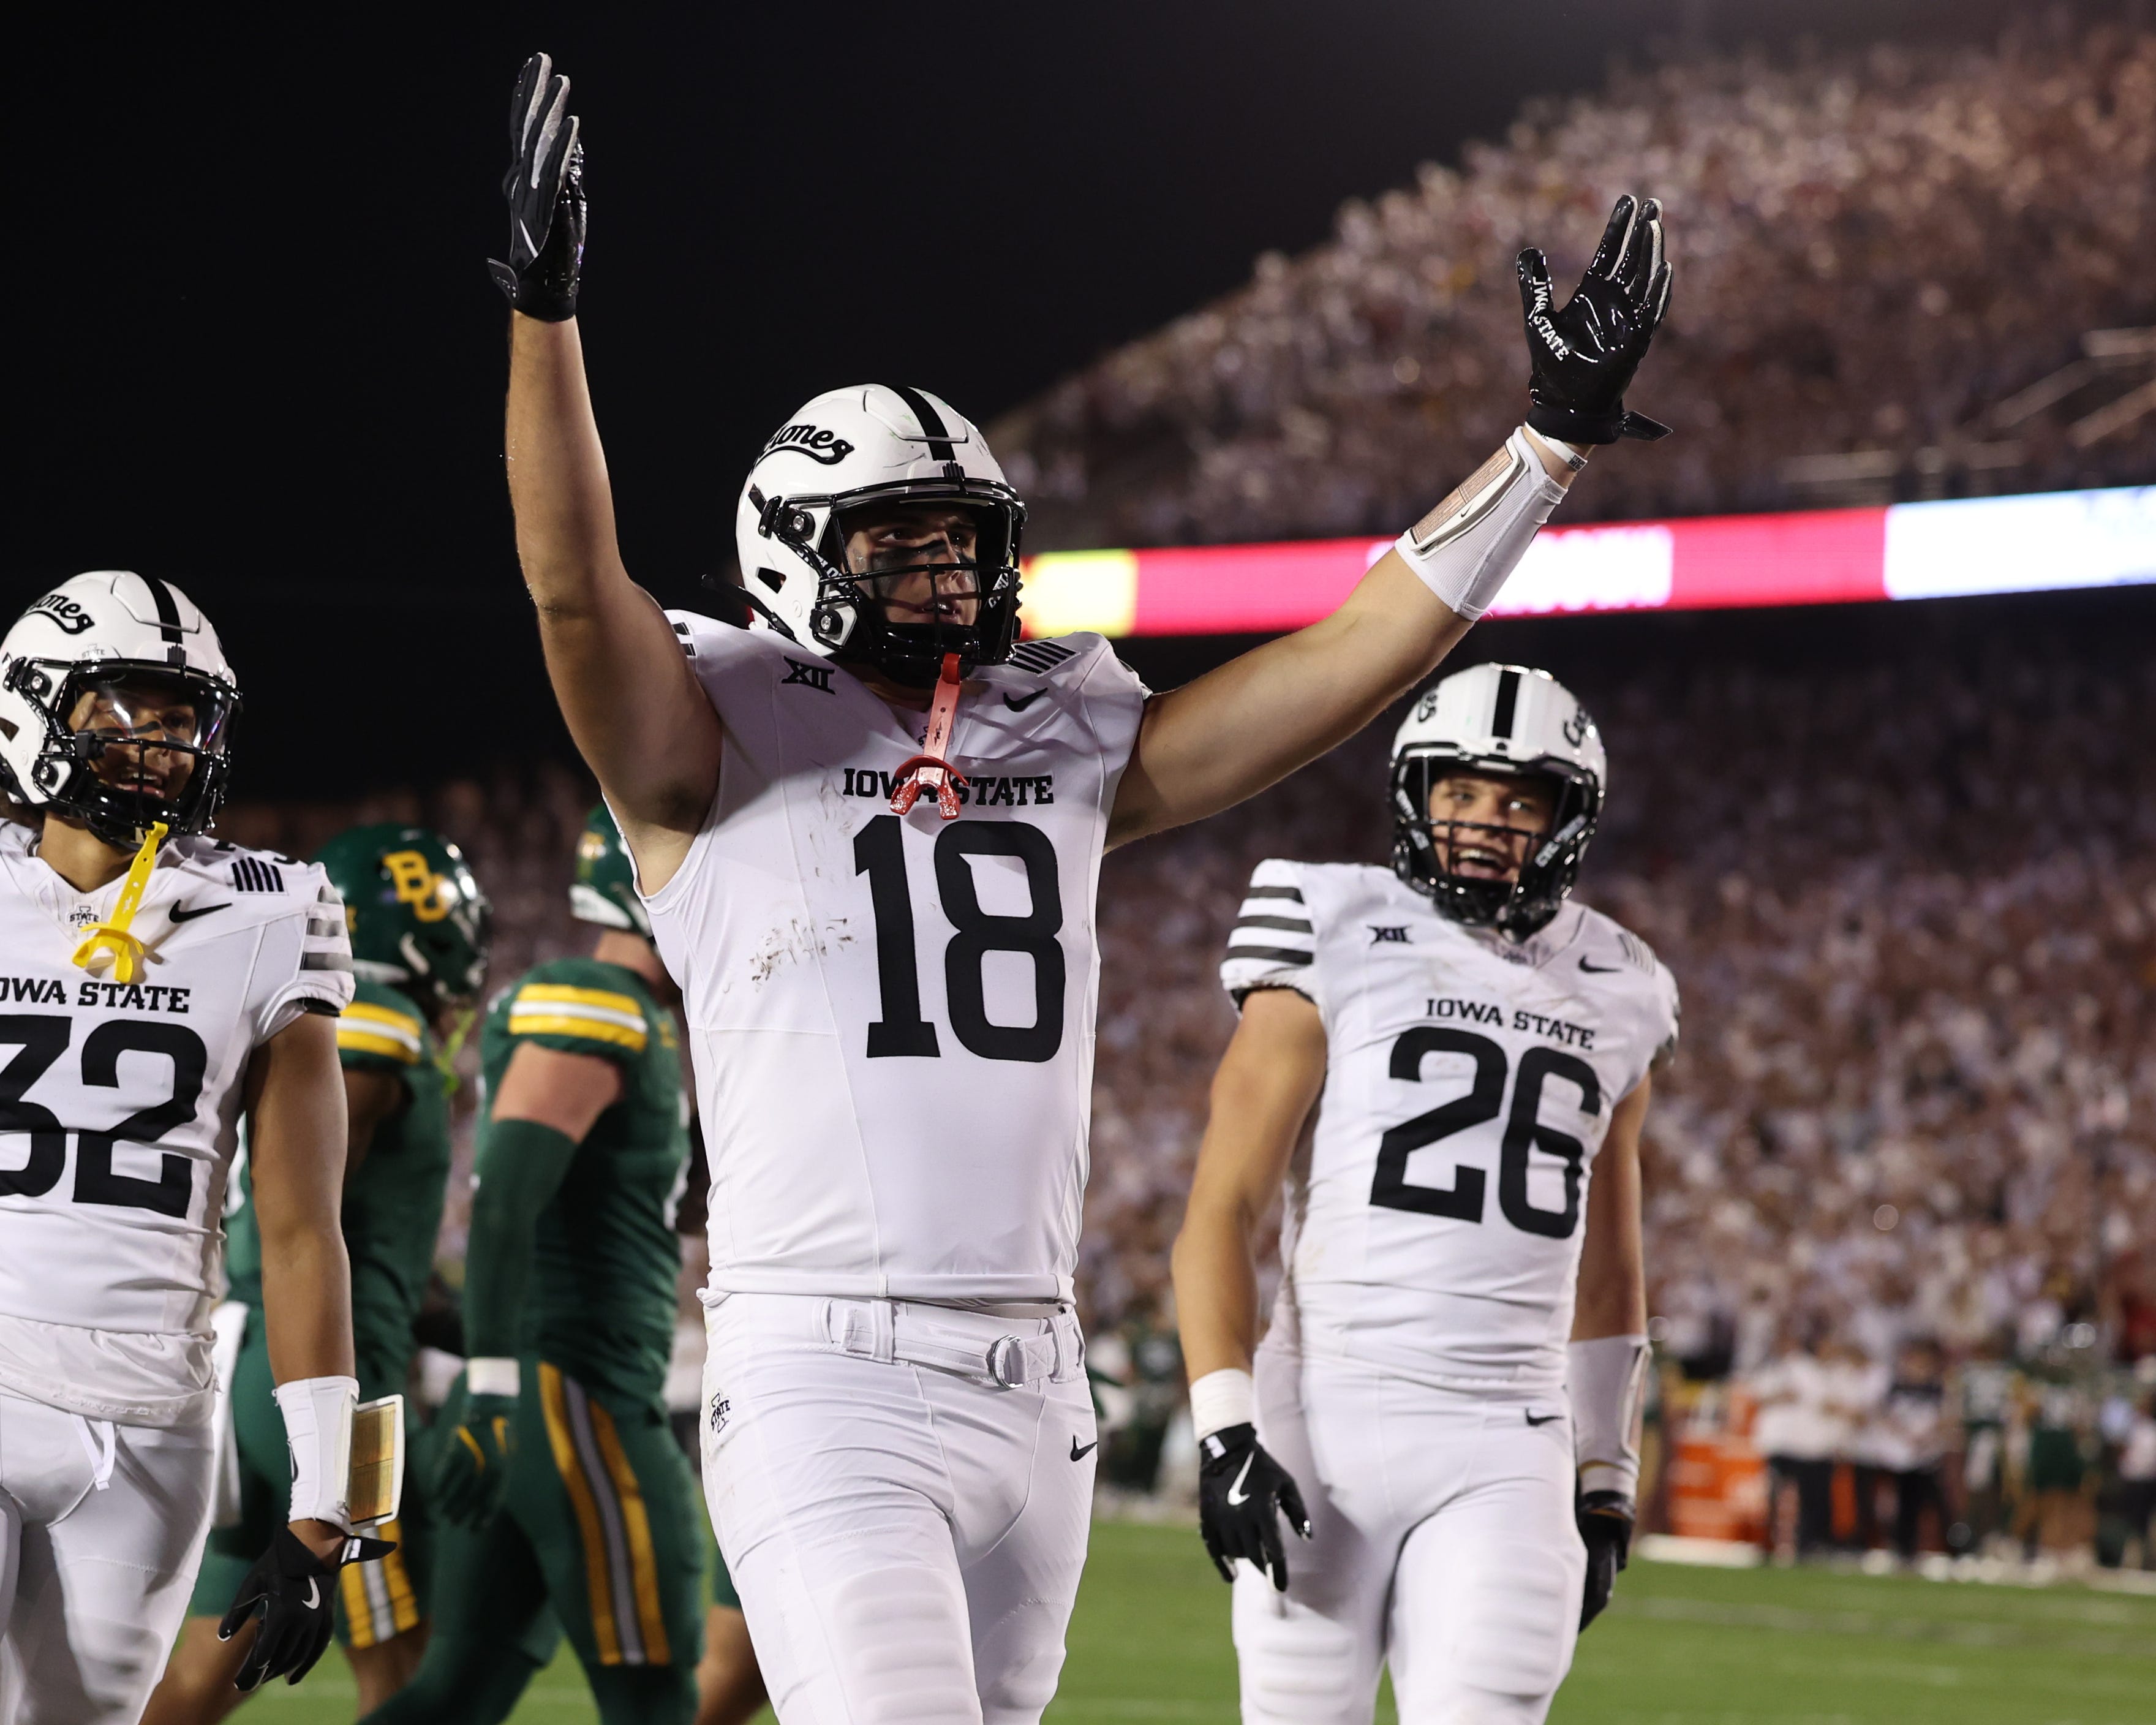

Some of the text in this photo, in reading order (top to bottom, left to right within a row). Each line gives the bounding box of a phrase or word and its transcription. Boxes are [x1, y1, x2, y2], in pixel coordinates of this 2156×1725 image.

[1534, 315, 1569, 361] STATE
[81, 648, 105, 660] STTE
[949, 775, 1054, 807] STATE
[853, 814, 1066, 1063] 18
[78, 981, 190, 1013] STATE
[1427, 998, 1596, 1050] IOWA STATE
[0, 1014, 208, 1220] 32
[1370, 1026, 1602, 1239] 26
